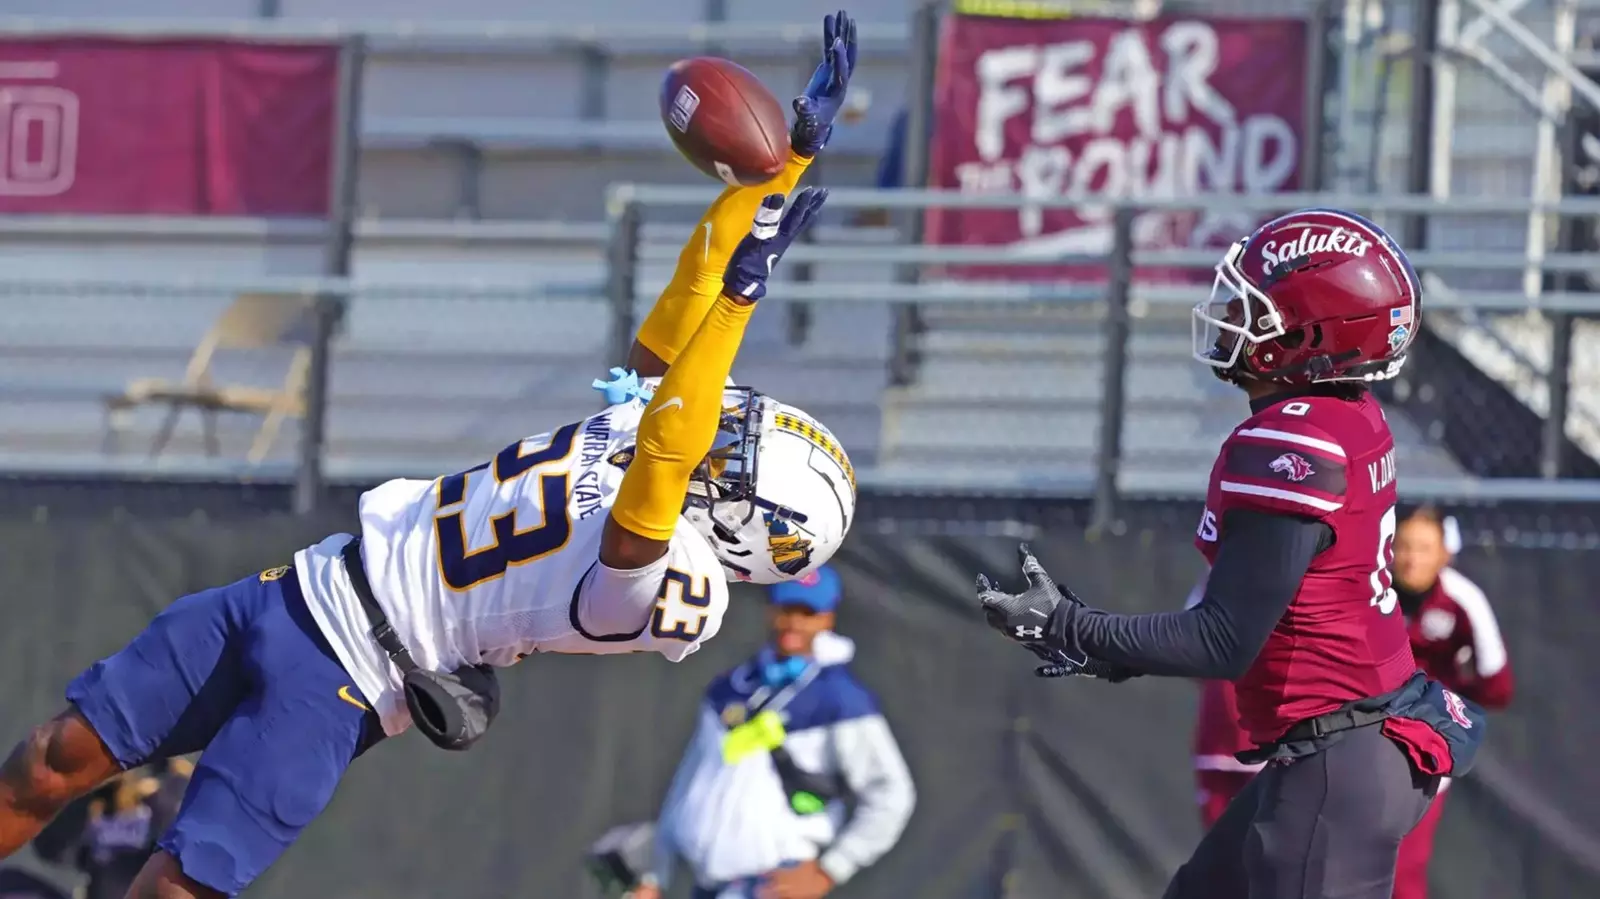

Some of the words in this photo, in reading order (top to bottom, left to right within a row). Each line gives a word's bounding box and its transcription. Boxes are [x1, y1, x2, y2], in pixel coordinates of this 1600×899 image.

[976, 21, 1236, 161] FEAR
[1018, 113, 1298, 237] POUND
[1261, 226, 1372, 275] Salukis
[581, 412, 613, 466] MURRAY
[433, 420, 585, 593] 23
[575, 470, 602, 520] STATE
[650, 566, 711, 642] 23
